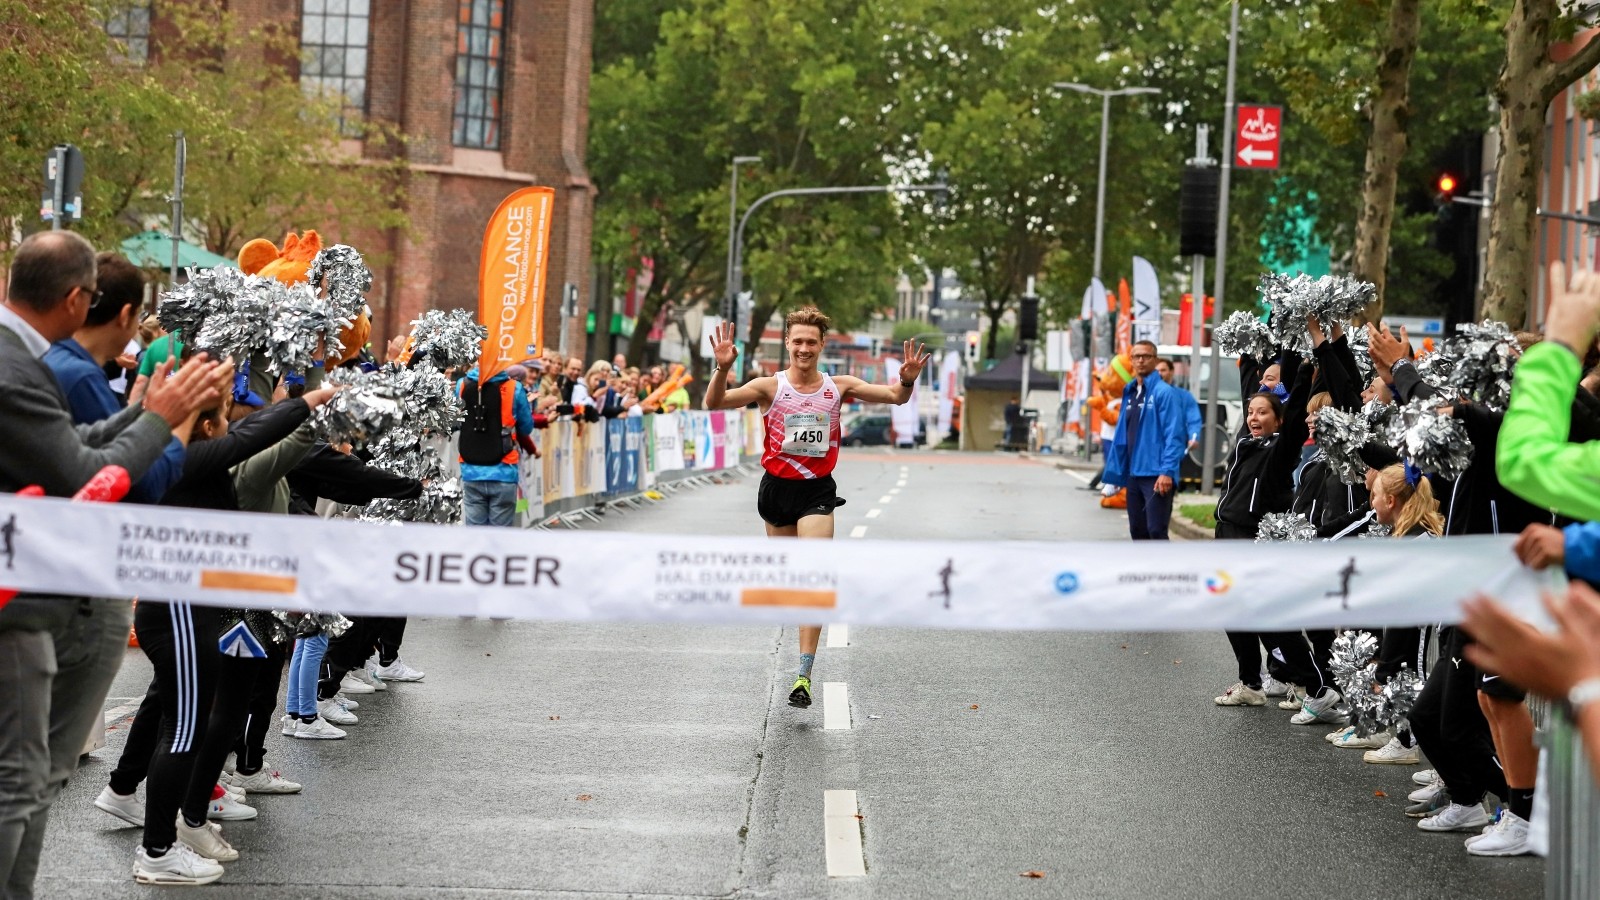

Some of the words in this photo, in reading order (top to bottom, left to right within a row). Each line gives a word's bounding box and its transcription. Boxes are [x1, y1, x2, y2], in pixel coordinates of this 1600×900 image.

[518, 206, 533, 306] www.fotobalance.com
[497, 206, 525, 362] FOTOBALANCE
[793, 430, 823, 443] 1450
[120, 523, 252, 547] STADTWERKE
[117, 543, 299, 573] HALBMARATHON
[394, 552, 562, 587] SIEGER
[657, 550, 788, 567] STADTWERKE
[116, 565, 193, 585] BOCHUM
